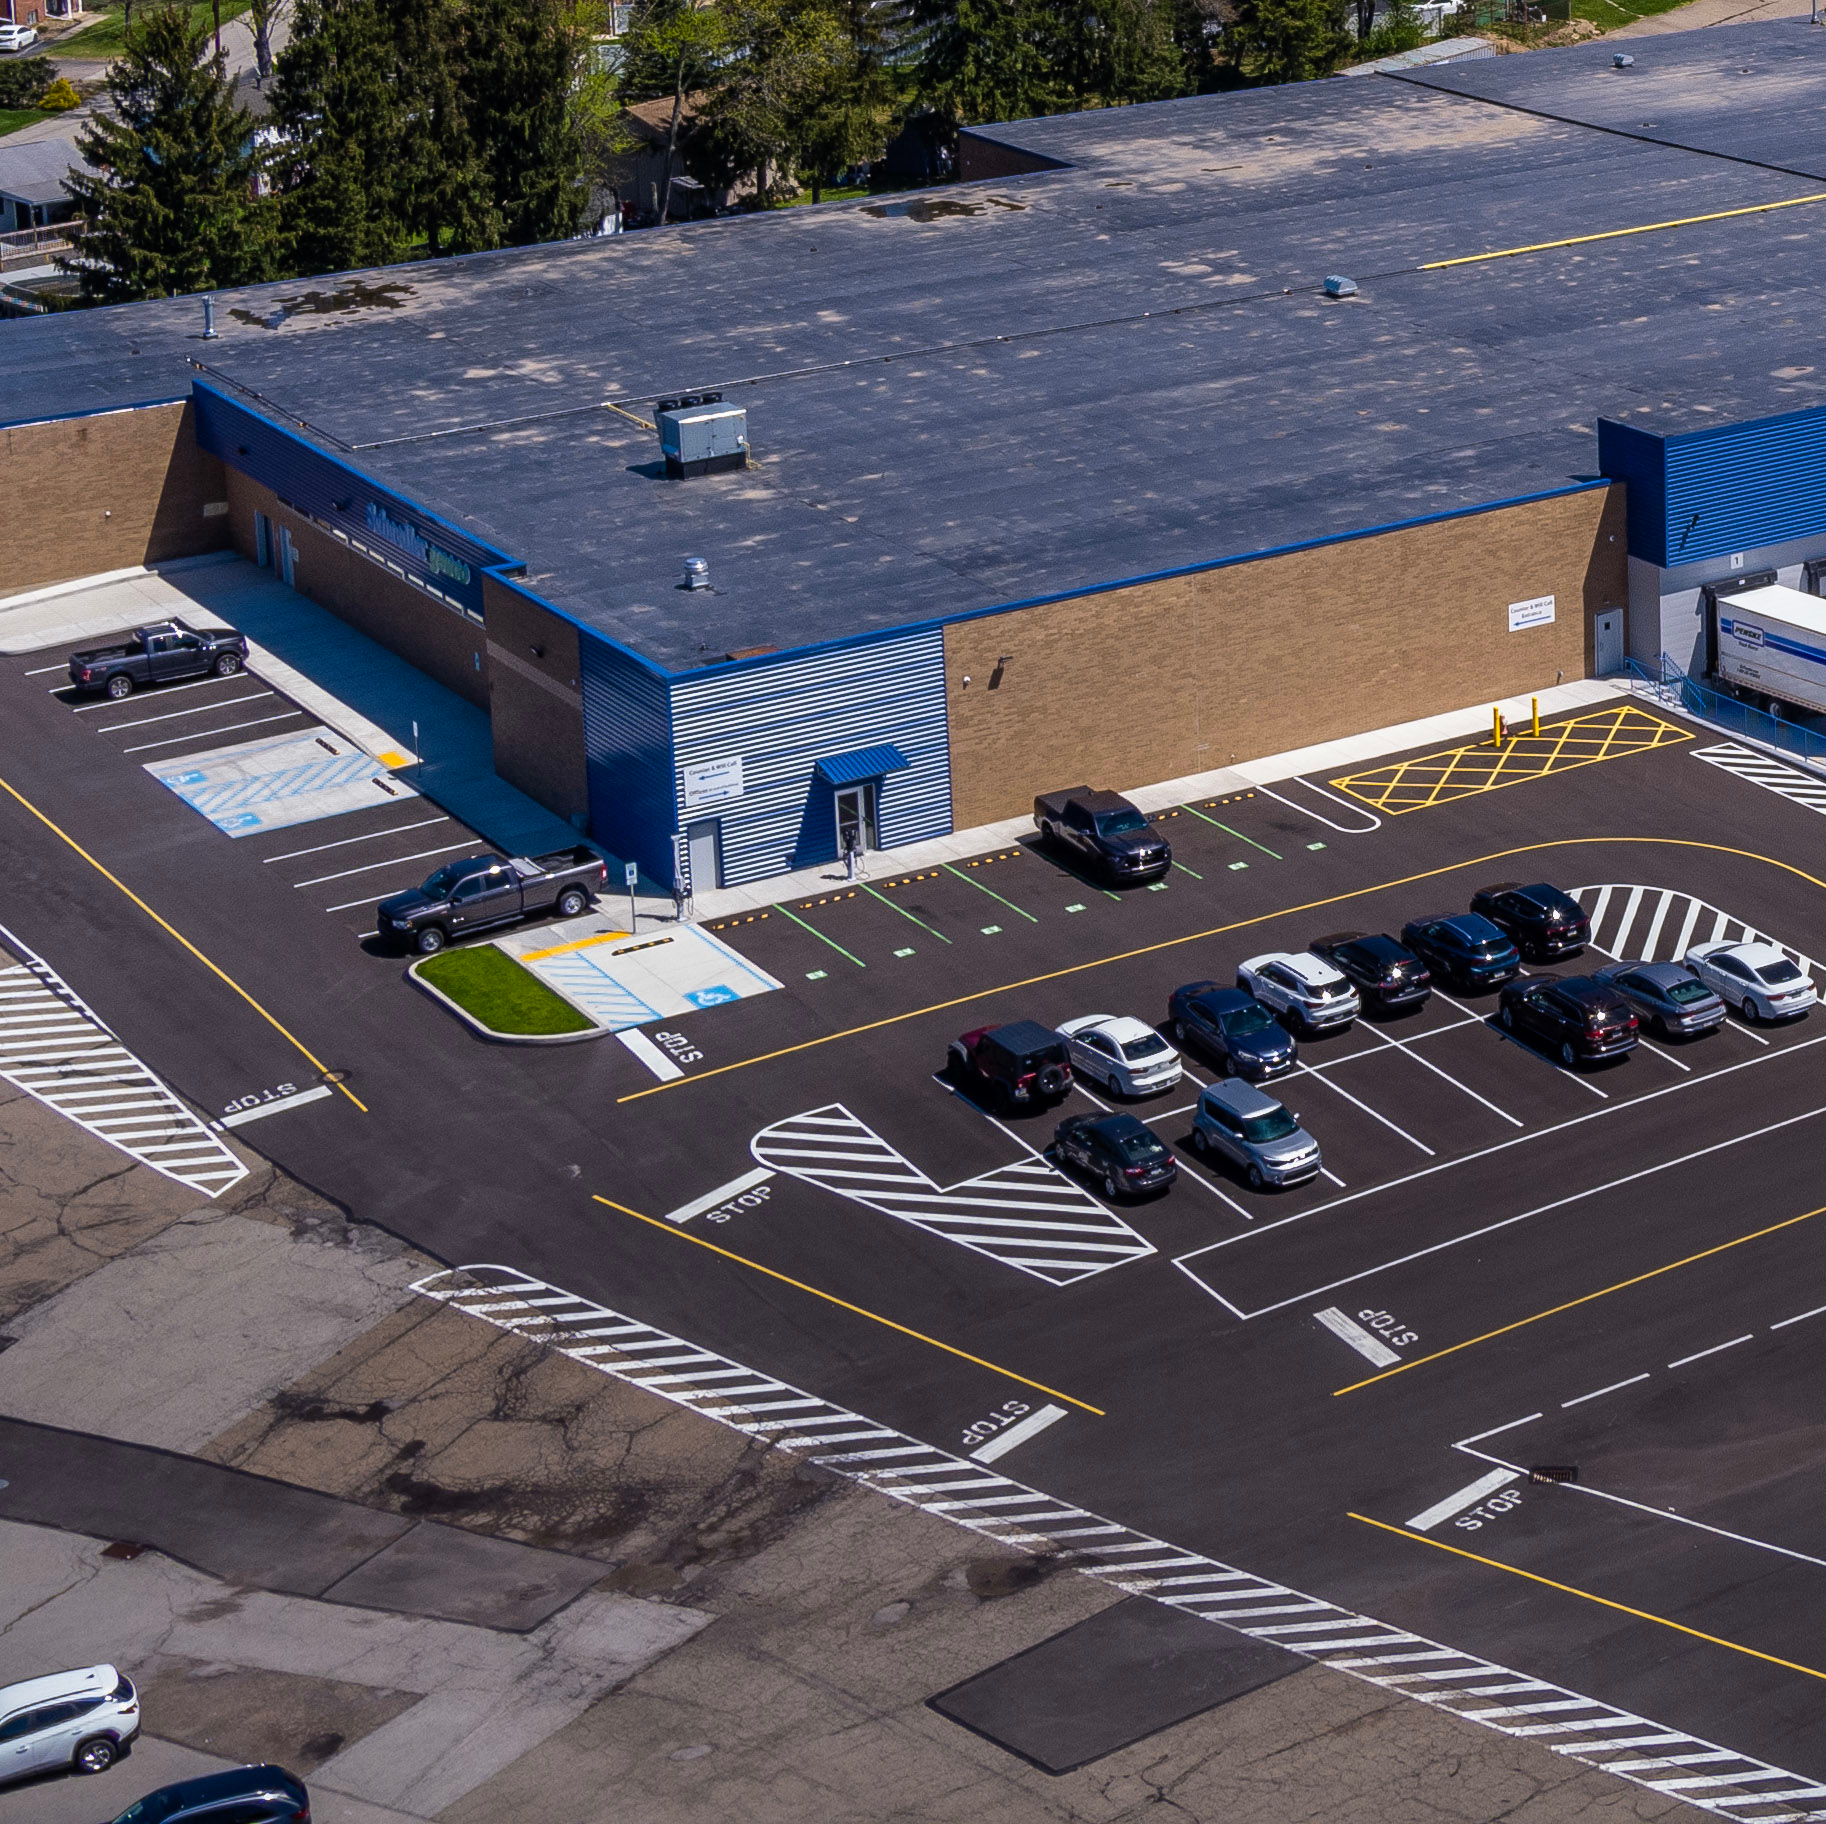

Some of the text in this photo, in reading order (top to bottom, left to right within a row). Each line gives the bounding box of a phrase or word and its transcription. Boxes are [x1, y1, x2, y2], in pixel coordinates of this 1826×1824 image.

[1733, 555, 1740, 566] 1
[1735, 626, 1762, 640] PENSKE
[655, 1031, 704, 1064] STOP
[224, 1082, 298, 1113] STOP
[706, 1186, 772, 1223] STOP
[1358, 1309, 1419, 1346] STOP
[961, 1400, 1031, 1445] STOP
[1454, 1489, 1523, 1530] STOP
